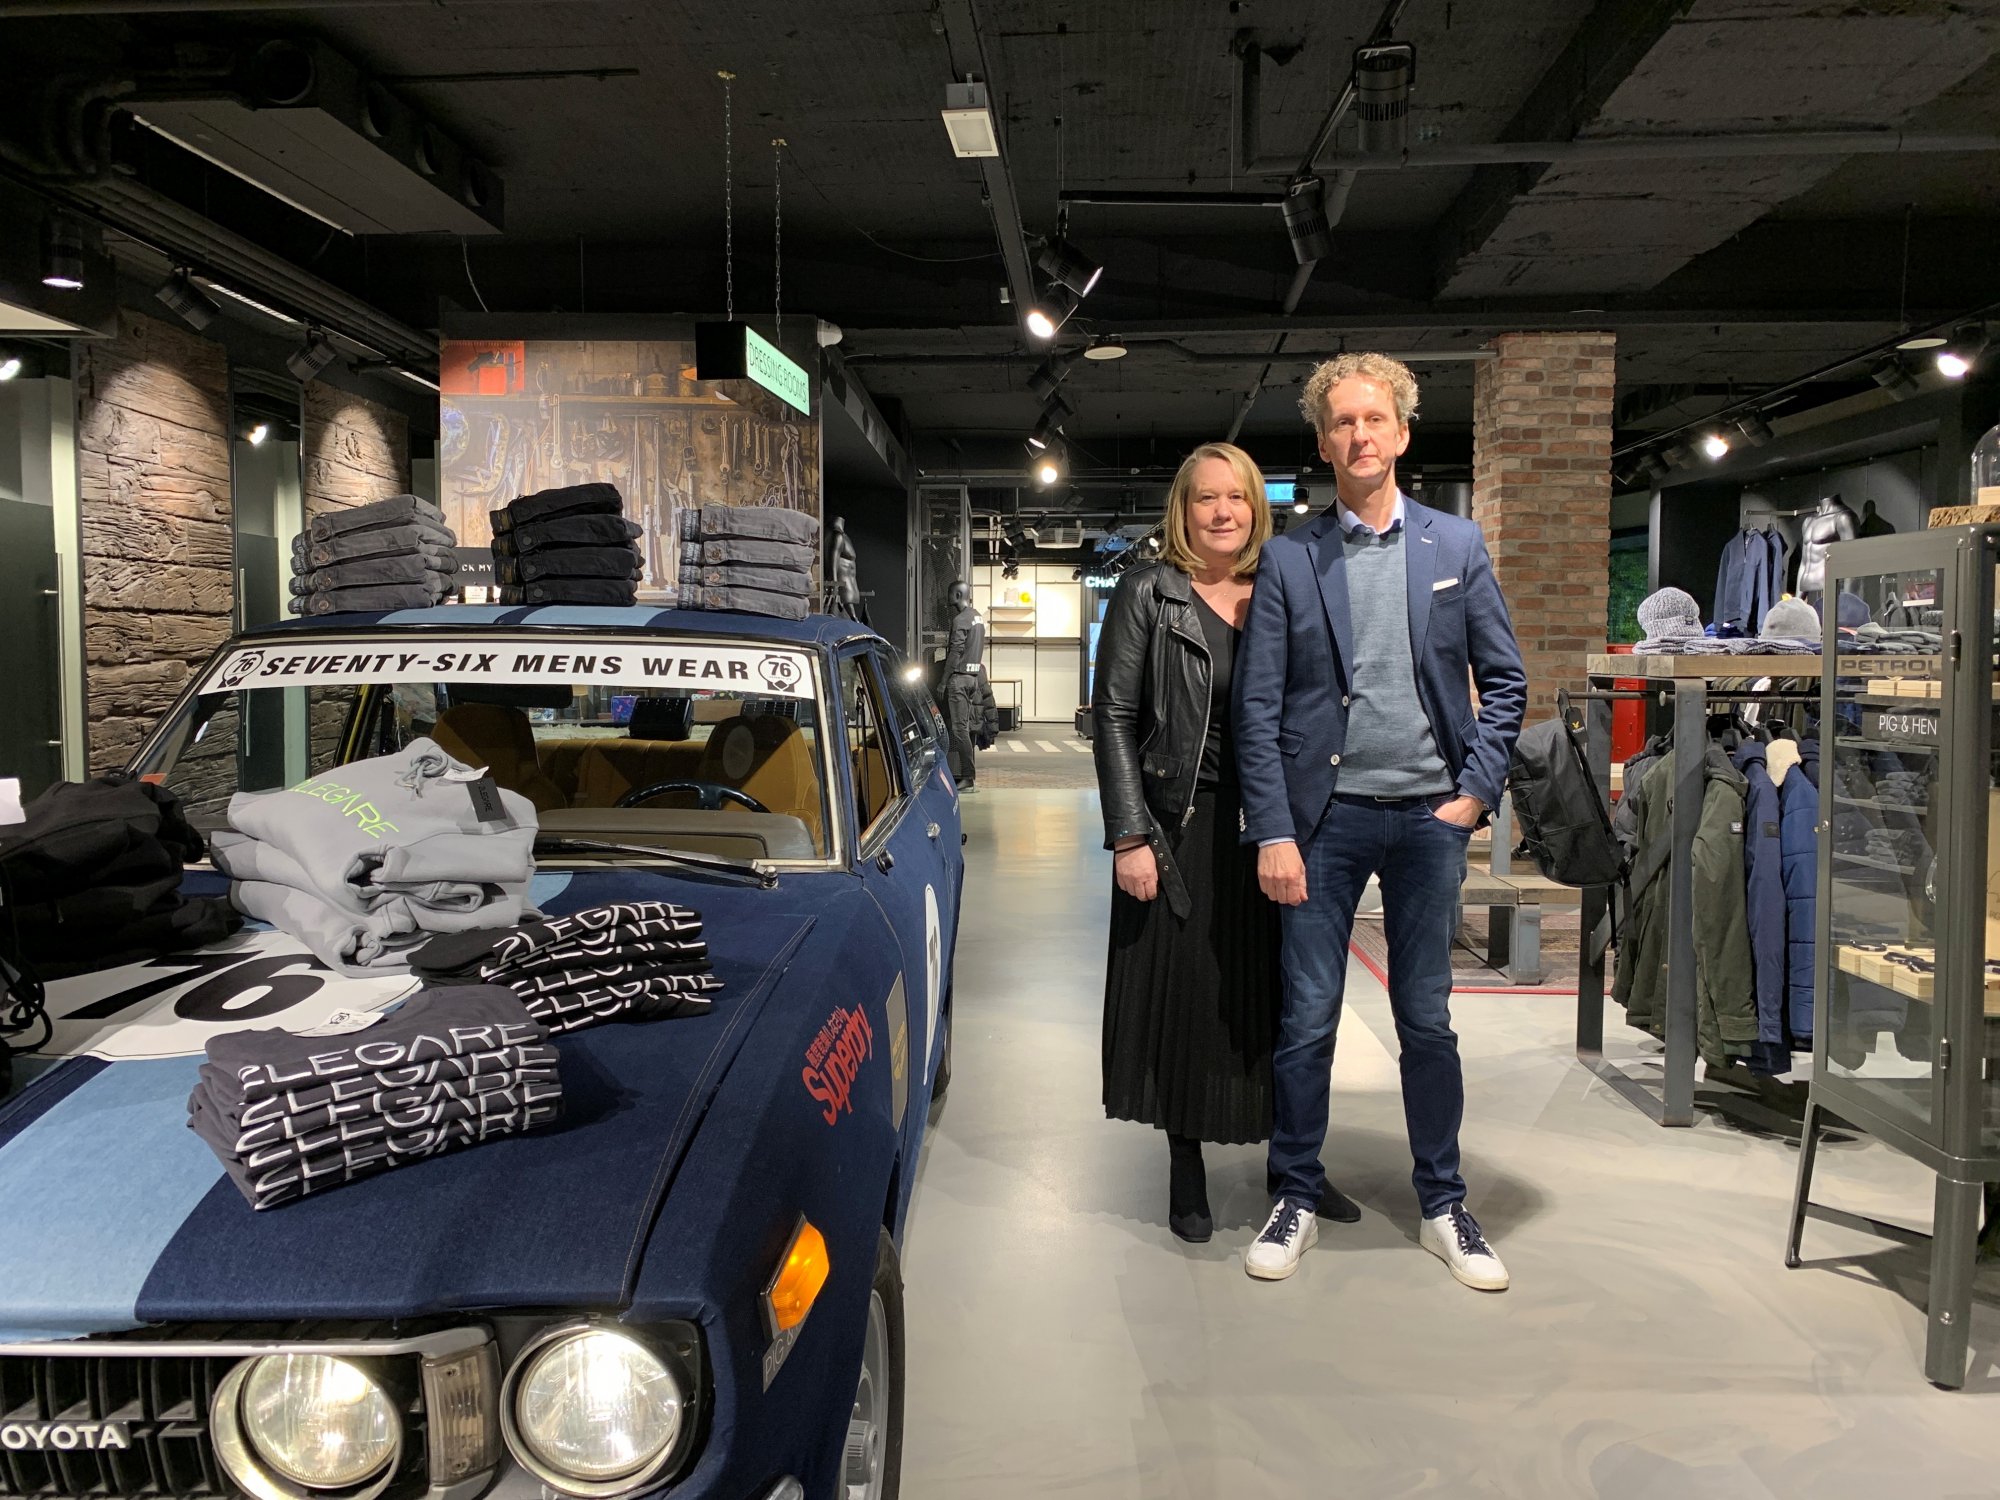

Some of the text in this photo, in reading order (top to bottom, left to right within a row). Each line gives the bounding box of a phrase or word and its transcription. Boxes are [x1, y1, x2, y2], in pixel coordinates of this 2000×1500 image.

[749, 341, 807, 404] DRESSING ROOMS
[478, 564, 492, 572] MY
[232, 657, 257, 673] 76
[260, 653, 749, 680] SEVENTY-SIX MENS WEAR
[768, 661, 792, 677] 76
[1879, 715, 1937, 736] PIG & HEN
[58, 950, 335, 1022] 76
[765, 1338, 784, 1382] PIG
[0, 1424, 126, 1450] OYOTA
